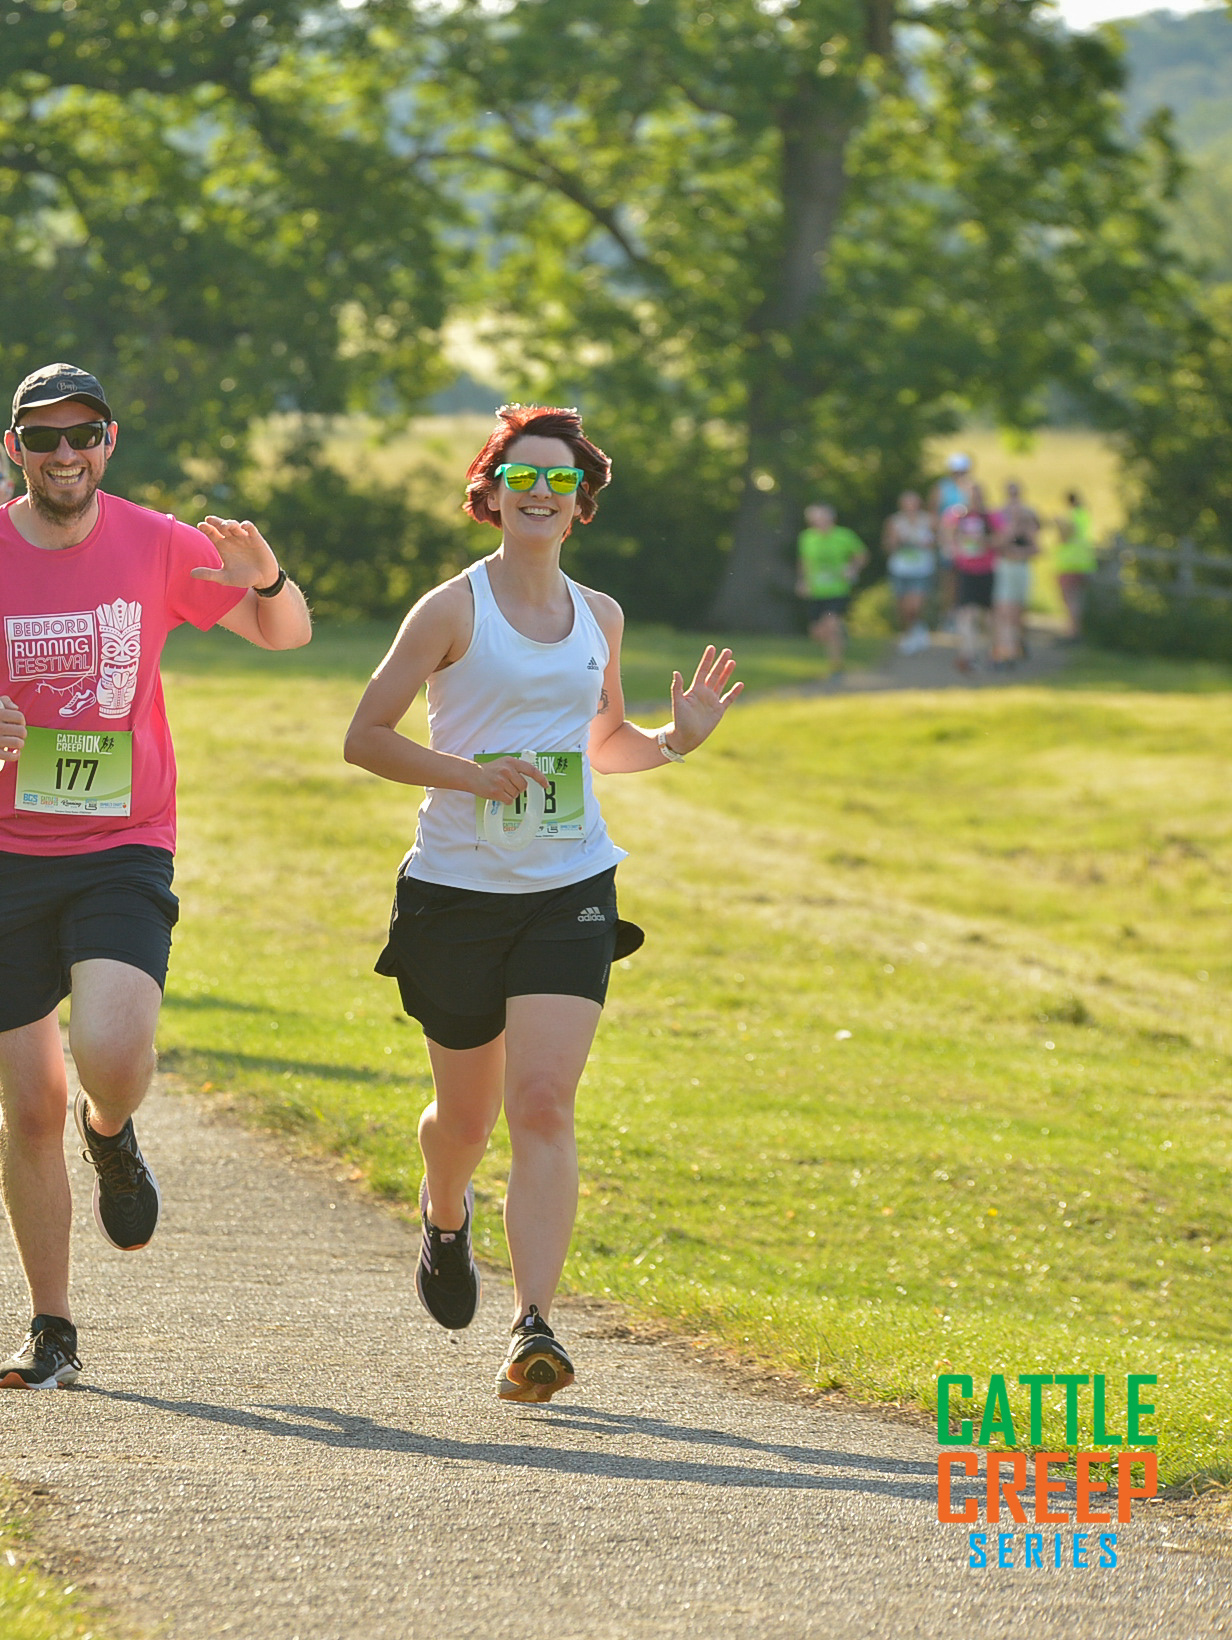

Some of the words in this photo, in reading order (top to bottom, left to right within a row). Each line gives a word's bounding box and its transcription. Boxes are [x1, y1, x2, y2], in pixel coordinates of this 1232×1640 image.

[13, 618, 88, 637] BEDFORD
[14, 637, 90, 657] RUNNING
[15, 654, 90, 674] FESTIVAL
[56, 733, 83, 744] CATTLE
[56, 742, 82, 752] CREEP
[82, 735, 100, 753] 10K
[55, 757, 99, 791] 177
[515, 781, 556, 815] 18
